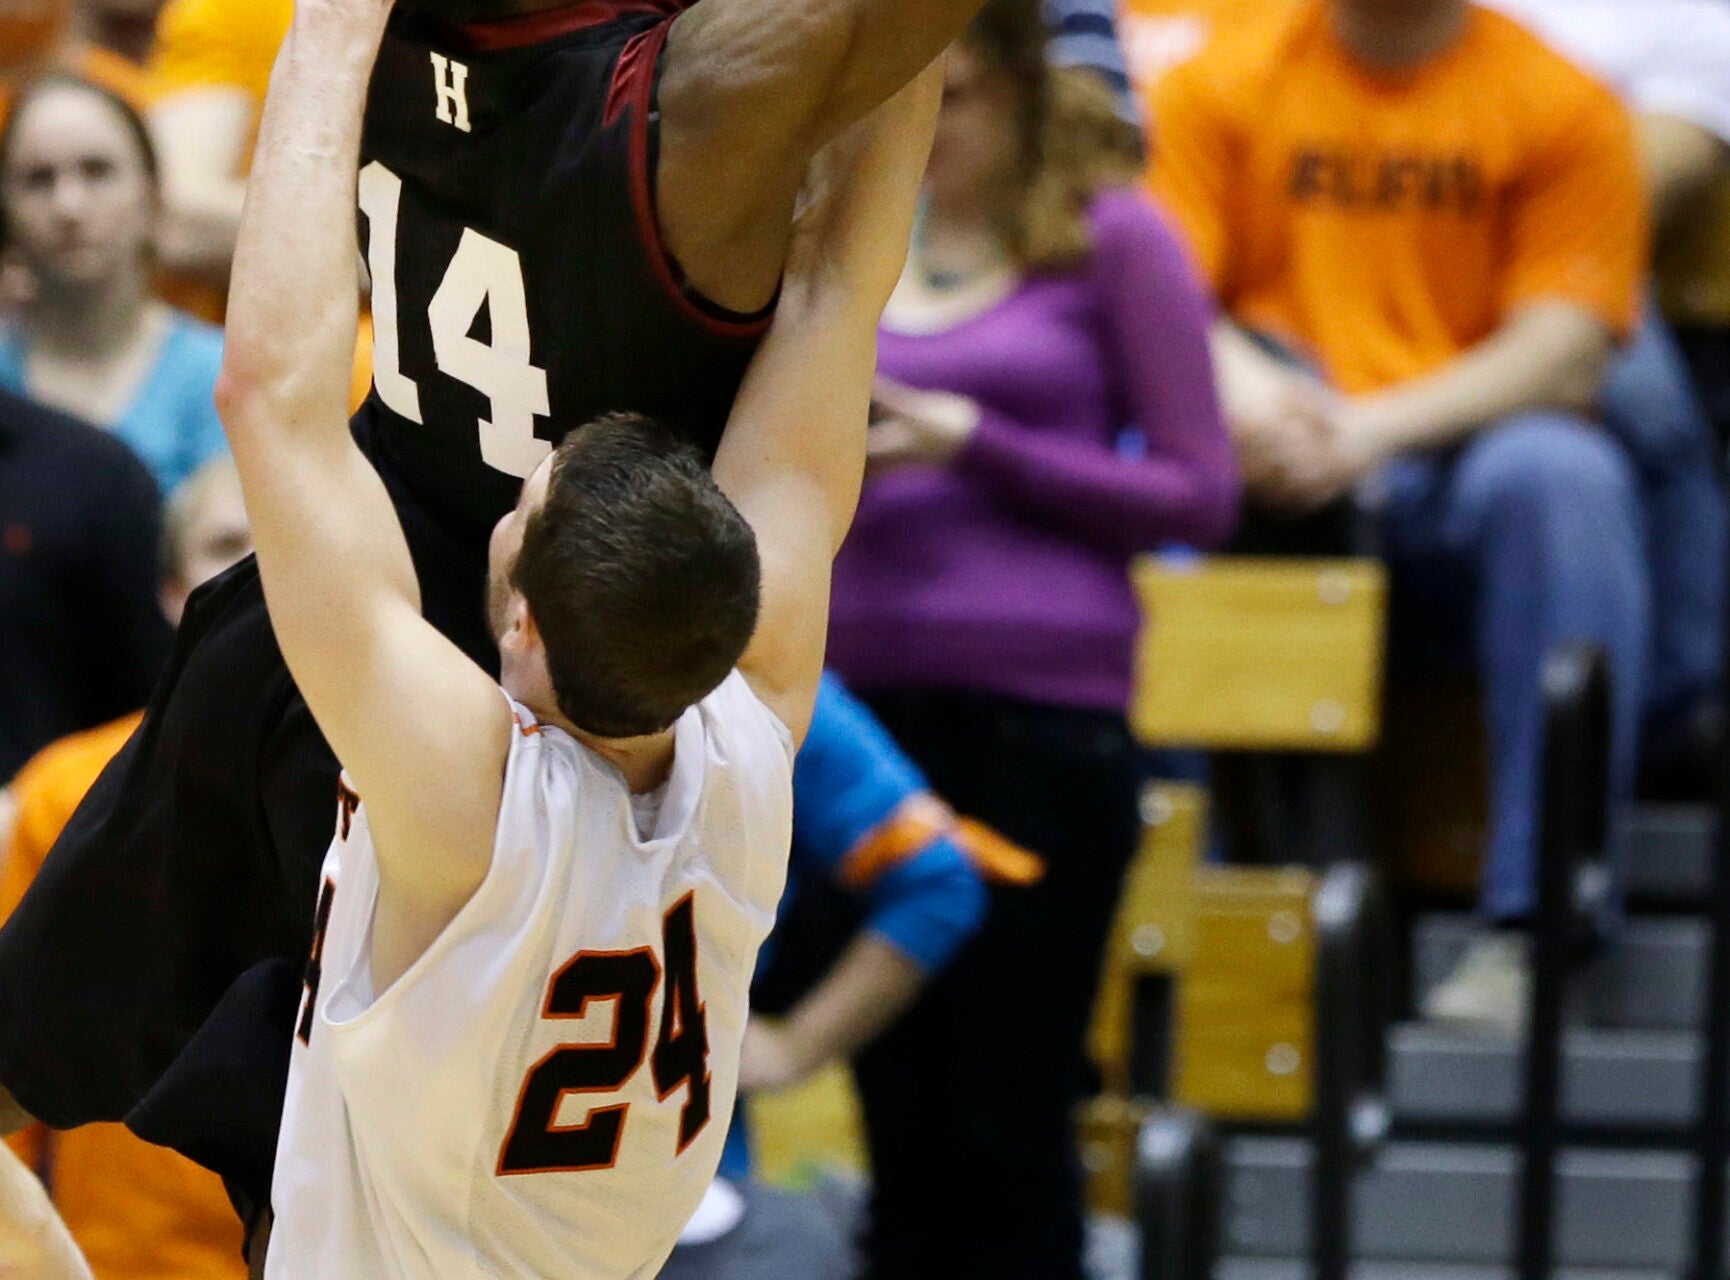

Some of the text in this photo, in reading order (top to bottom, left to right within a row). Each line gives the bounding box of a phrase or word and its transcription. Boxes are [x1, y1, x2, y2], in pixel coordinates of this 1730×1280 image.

[430, 51, 471, 133] H
[358, 160, 553, 480] 14
[495, 889, 712, 1177] 24
